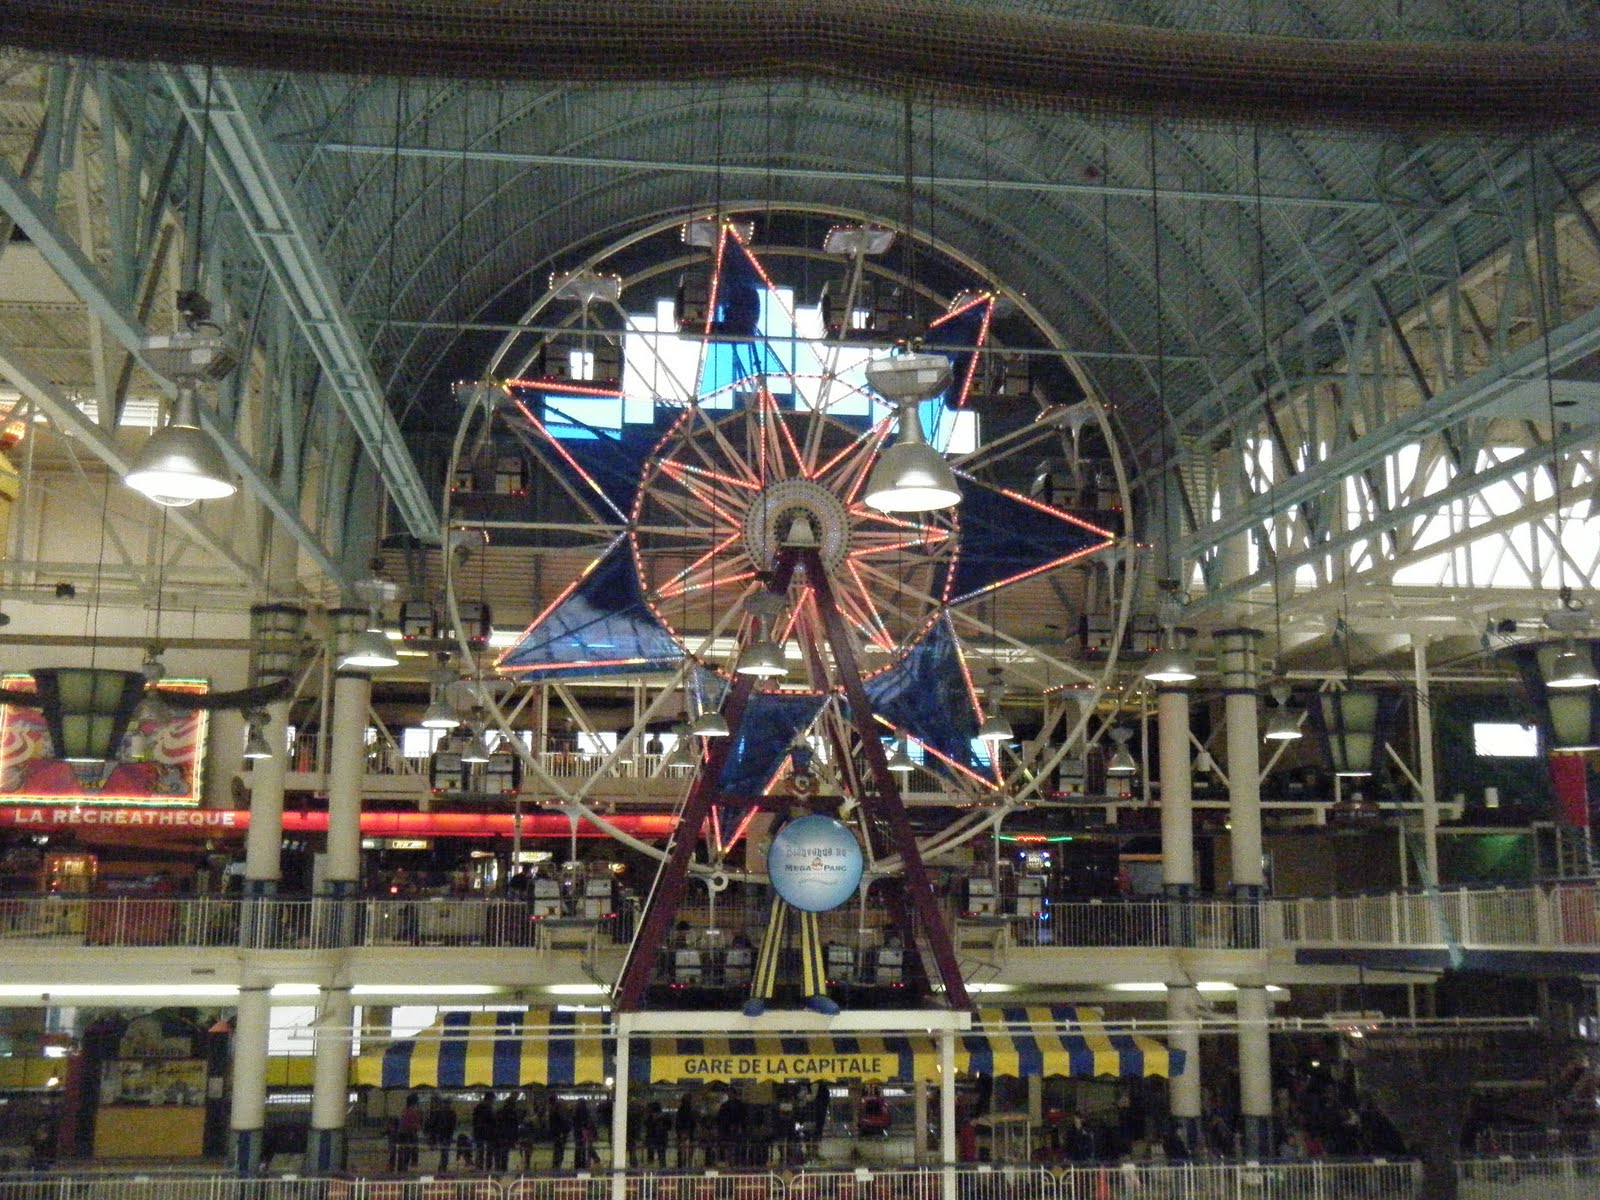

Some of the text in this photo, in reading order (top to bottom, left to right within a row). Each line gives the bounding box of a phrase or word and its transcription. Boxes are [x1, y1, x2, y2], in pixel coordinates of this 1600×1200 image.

[15, 809, 43, 823] LA
[784, 864, 847, 872] MEGA PARC
[684, 1058, 881, 1075] GARE DE LA CAPITALE
